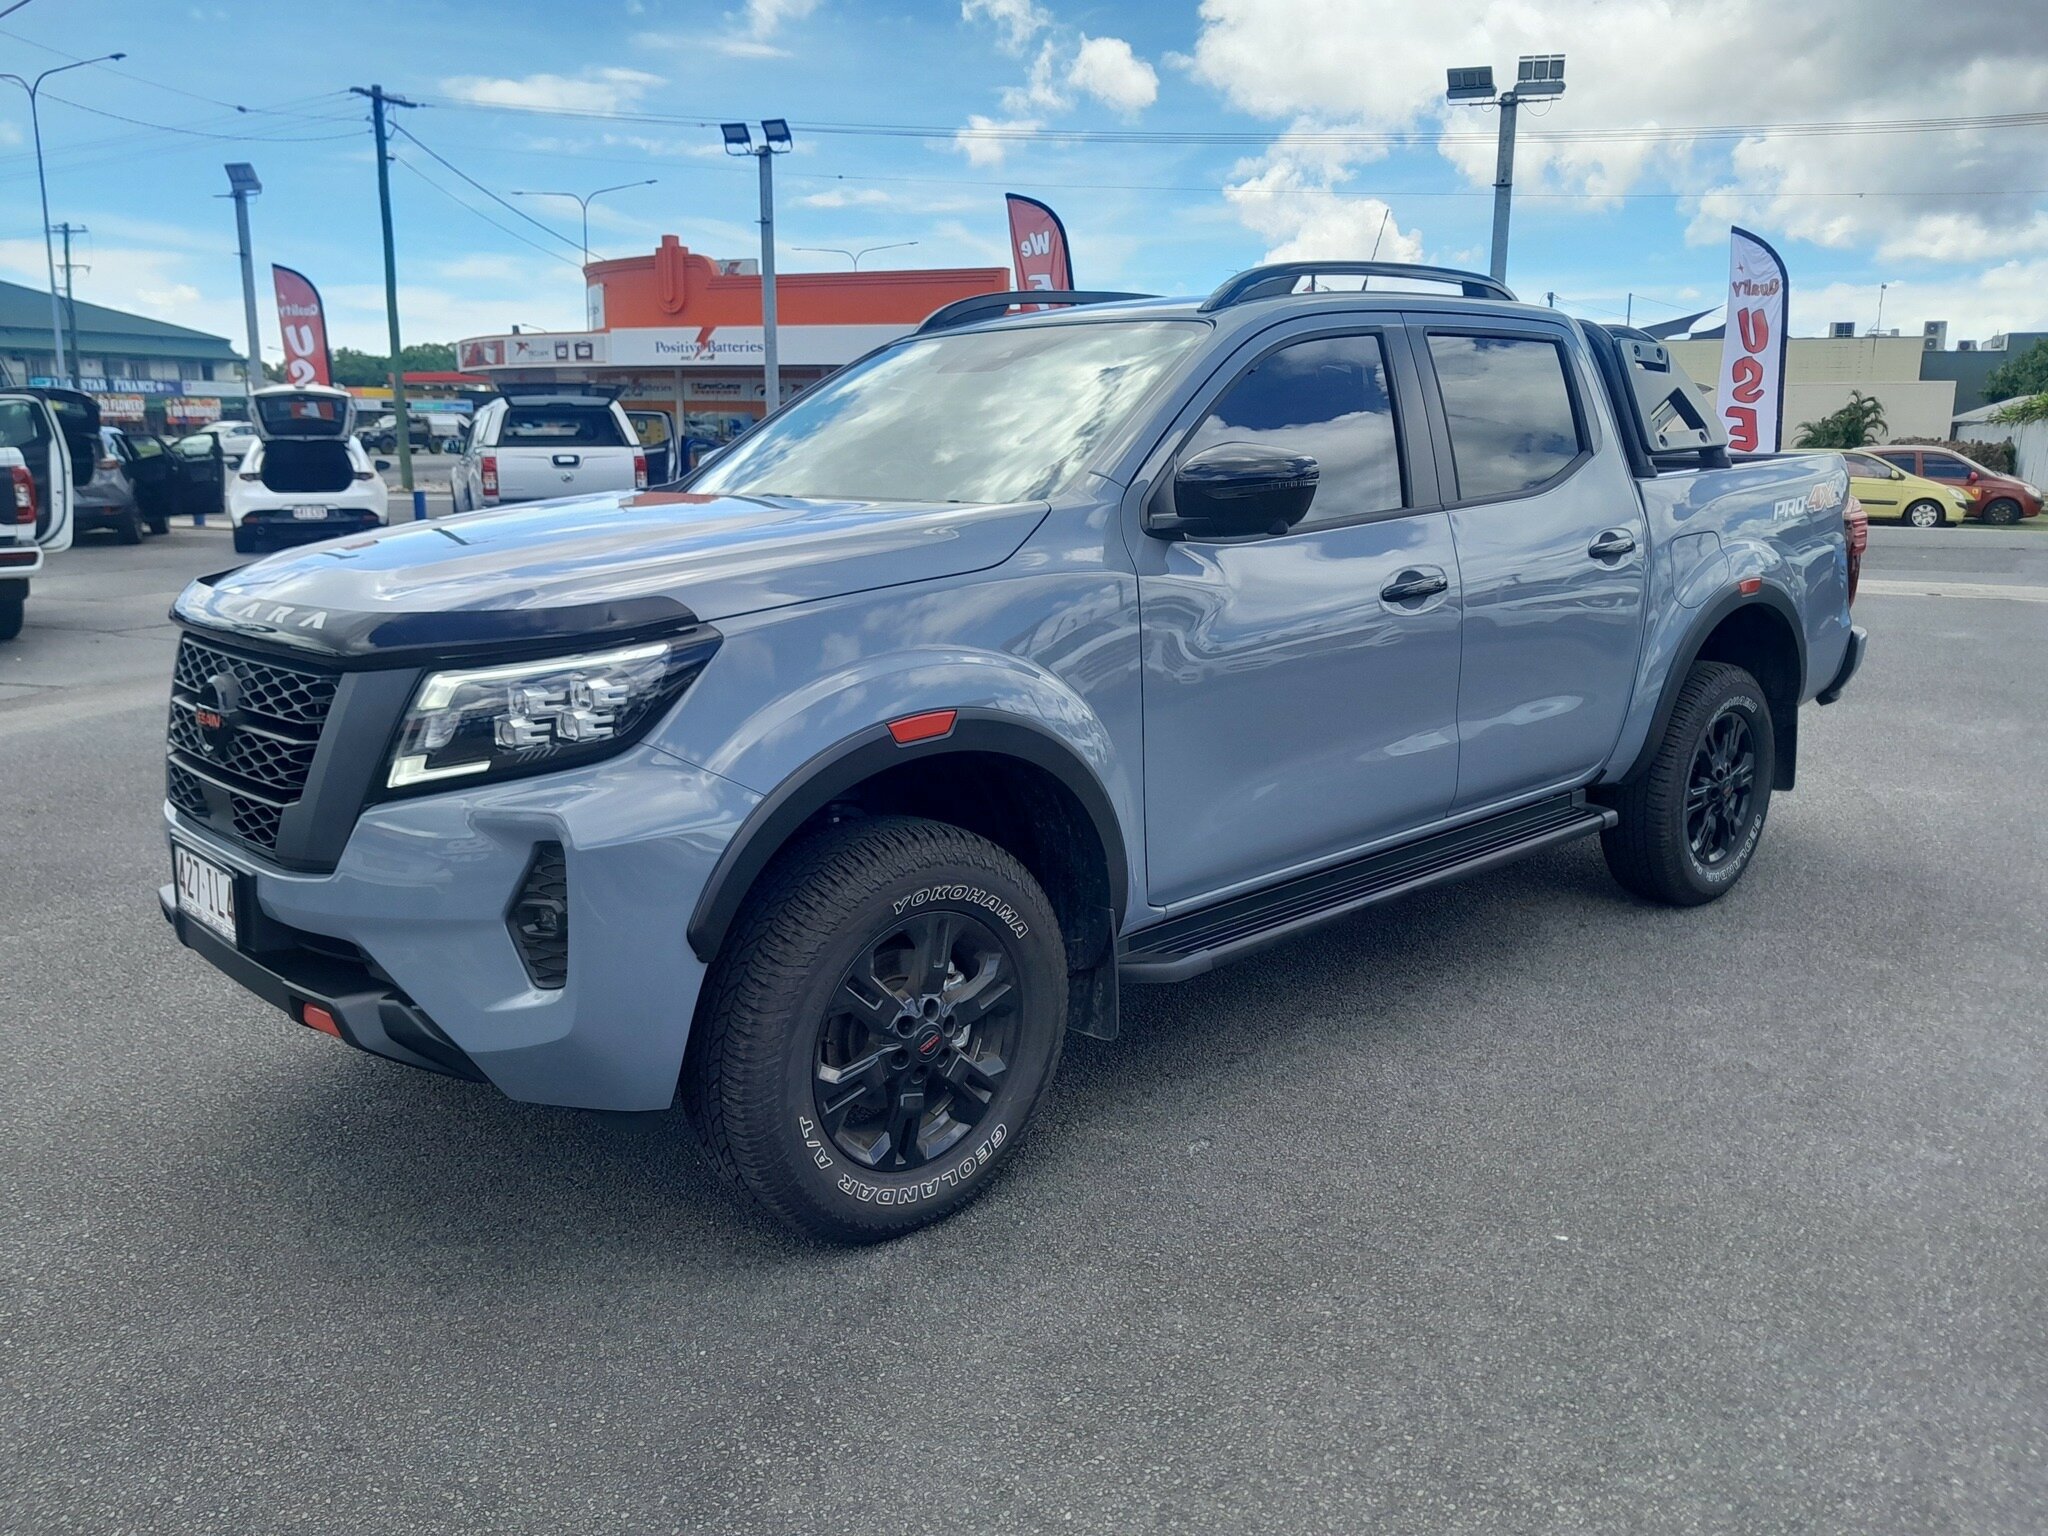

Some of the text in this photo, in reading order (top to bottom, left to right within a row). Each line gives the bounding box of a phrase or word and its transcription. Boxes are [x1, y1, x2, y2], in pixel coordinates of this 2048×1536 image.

[655, 340, 765, 353] Positive Batteries
[114, 379, 157, 392] FINANCE
[893, 884, 1029, 940] YOKOHAMA
[799, 1116, 1008, 1206] GEOLANDAR A/T
